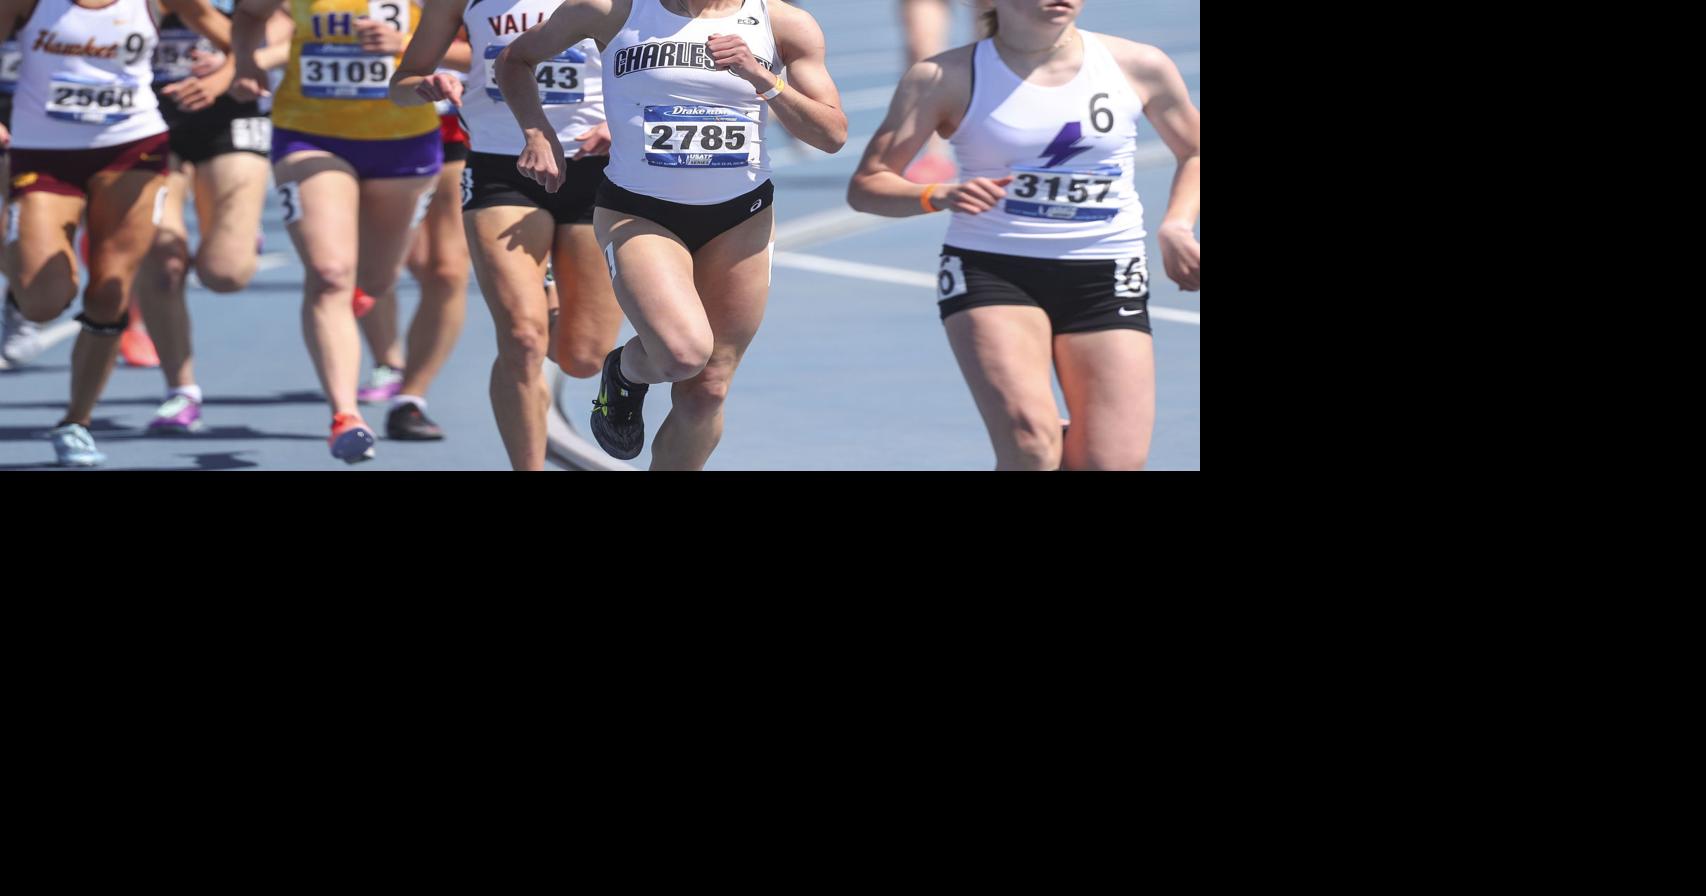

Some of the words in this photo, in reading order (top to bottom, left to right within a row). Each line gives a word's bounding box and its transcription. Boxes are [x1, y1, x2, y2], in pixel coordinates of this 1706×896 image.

[380, 3, 400, 32] 3
[125, 32, 145, 65] 9
[306, 60, 388, 83] 3109
[671, 105, 705, 116] Drake
[1088, 92, 1114, 134] 6
[650, 124, 746, 151] 2785
[1013, 173, 1113, 204] 3157
[1122, 257, 1146, 294] 6
